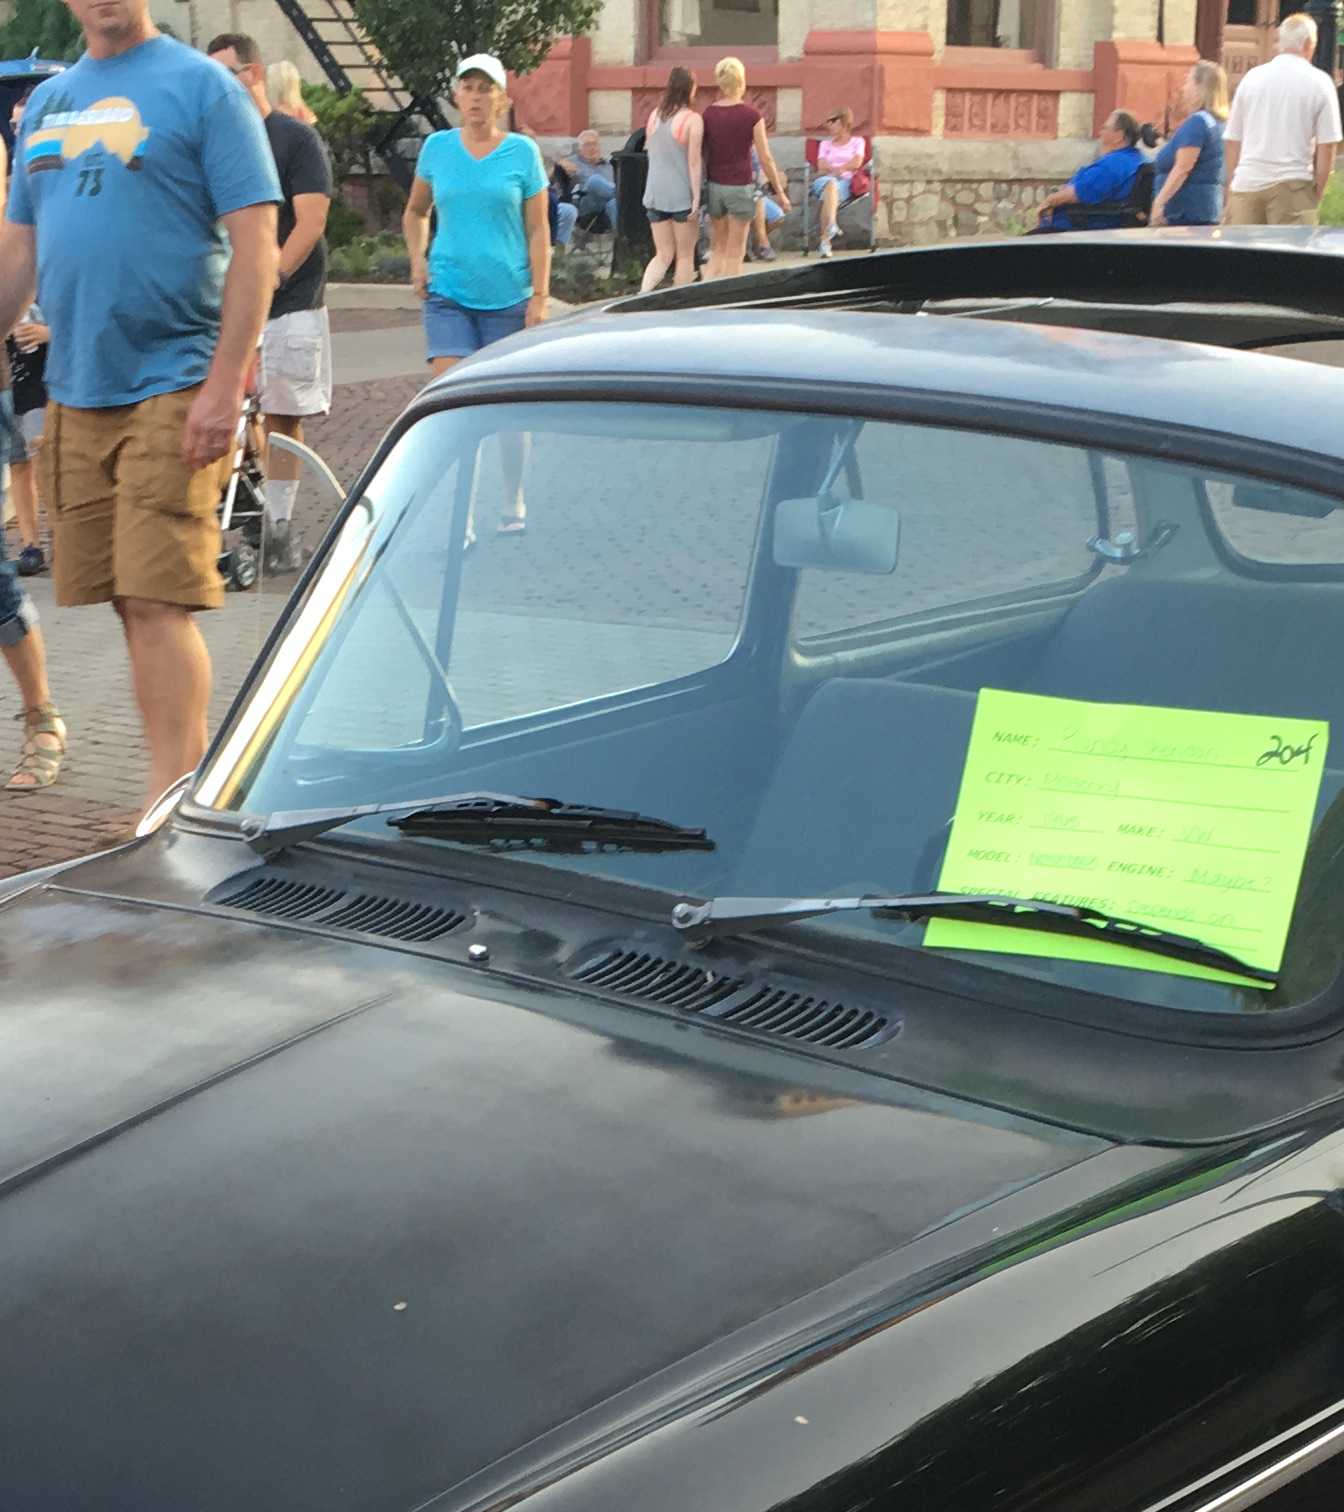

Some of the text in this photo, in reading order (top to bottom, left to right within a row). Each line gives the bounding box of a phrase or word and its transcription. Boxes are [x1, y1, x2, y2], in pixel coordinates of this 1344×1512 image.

[991, 730, 1041, 748] NAME:
[1256, 732, 1321, 767] 204
[983, 770, 1033, 788] CITY:
[976, 809, 1024, 826] YEAR:
[1115, 823, 1166, 839] MAKE:
[966, 848, 1023, 864] MODEL:
[1105, 860, 1175, 879] ENGINE:
[959, 885, 1021, 901] SPECIAL
[1032, 890, 1117, 911] FEATURES:
